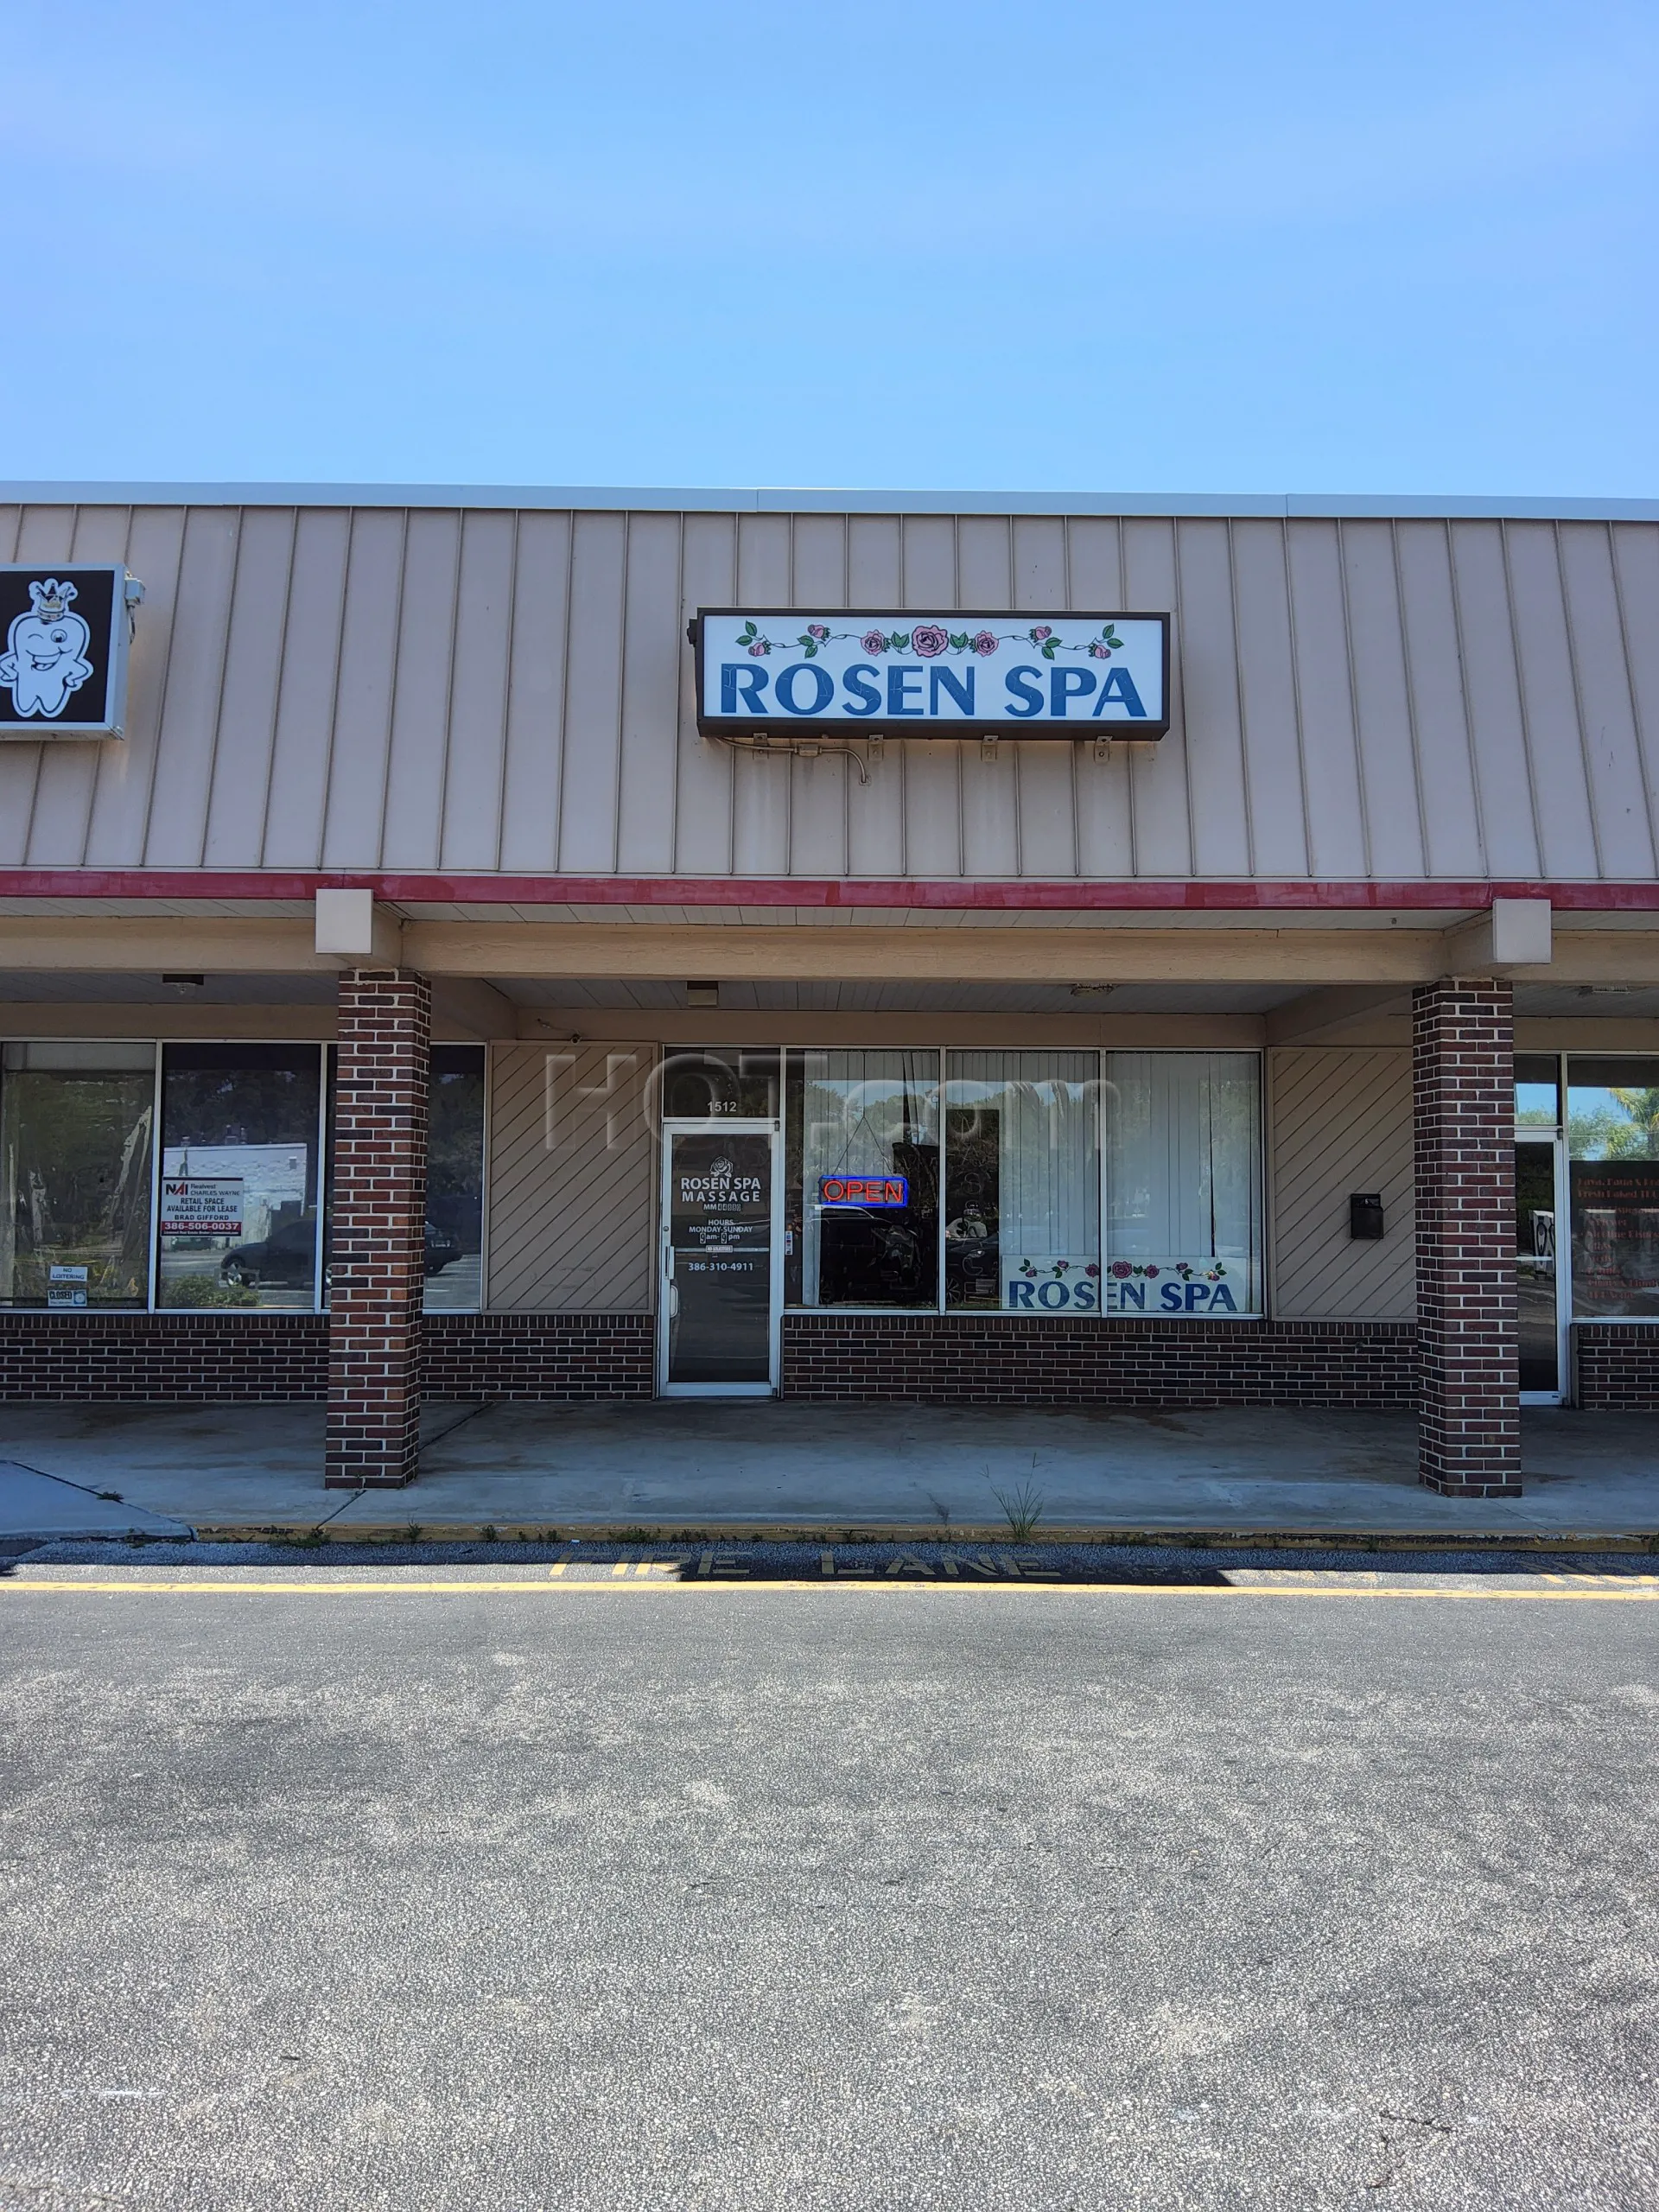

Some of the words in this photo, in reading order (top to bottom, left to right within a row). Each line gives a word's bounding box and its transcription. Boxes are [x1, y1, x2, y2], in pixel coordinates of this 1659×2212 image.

[721, 663, 976, 716] ROSEN
[1004, 665, 1147, 717] SPA
[707, 1101, 737, 1112] 1512
[165, 1181, 188, 1196] NAI
[681, 1177, 730, 1190] ROSEN
[734, 1177, 761, 1190] SPA
[682, 1191, 760, 1202] MASSAGE
[823, 1179, 903, 1202] OPEN
[164, 1222, 238, 1230] 386-506-0037
[688, 1262, 753, 1271] 386-310-4911
[49, 1291, 73, 1300] CLOSED
[1008, 1281, 1145, 1310] ROSEN
[1160, 1282, 1237, 1312] SPA
[549, 1552, 750, 1575] FIRE
[821, 1552, 1062, 1577] LANE
